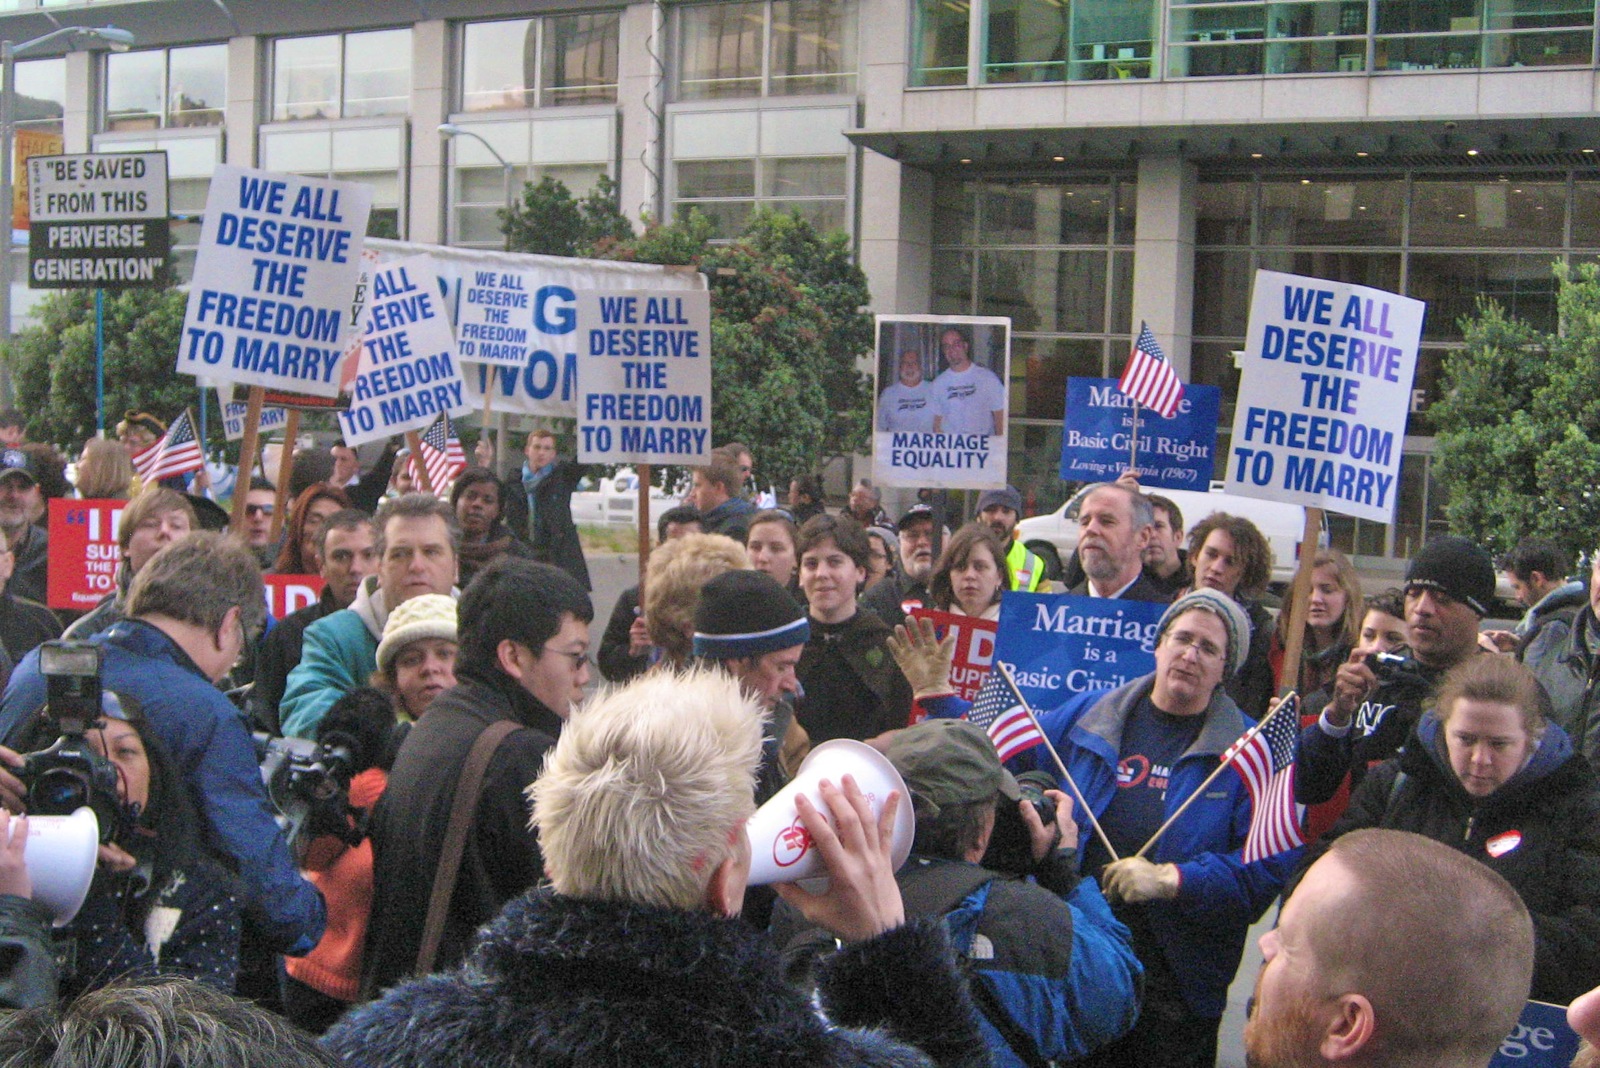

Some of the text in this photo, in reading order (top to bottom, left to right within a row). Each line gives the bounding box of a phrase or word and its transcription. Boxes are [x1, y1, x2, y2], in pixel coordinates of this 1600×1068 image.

[46, 158, 146, 181] "BE SAVED
[47, 192, 95, 213] FROM
[101, 191, 148, 212] THIS
[239, 176, 342, 223] WE ALL
[48, 224, 146, 249] PERVERSE
[216, 212, 351, 264] DESERVE
[33, 257, 163, 281] GENERATION"
[252, 258, 307, 298] THE
[374, 266, 417, 300] ALL
[475, 271, 524, 291] WE ALL
[467, 288, 529, 309] DESERVE
[599, 297, 689, 325] WE ALL
[1284, 285, 1394, 338] WE ALL
[197, 290, 341, 343] FREEDOM
[365, 293, 435, 335] ERVE
[485, 307, 510, 325] THE
[364, 331, 412, 365] THE
[462, 323, 527, 344] FREEDOM
[589, 329, 699, 358] DESERVE
[187, 327, 341, 383] TO MARRY
[458, 340, 528, 361] TO MARRY
[1261, 324, 1403, 383] DESERVE
[355, 351, 454, 401] REEDOM
[621, 362, 667, 389] THE
[342, 380, 463, 436] TO MARRY
[586, 393, 703, 422] FREEDOM
[1301, 372, 1360, 415] THE
[225, 419, 240, 434] TO
[581, 425, 708, 455] TO MARRY
[892, 432, 990, 450] MARRIAGE
[1244, 406, 1394, 467] FREEDOM
[891, 450, 989, 469] EQUALITY
[1068, 430, 1108, 449] Basic
[1157, 436, 1209, 462] Right
[1069, 459, 1108, 475] Loving
[1235, 447, 1393, 508] TO MARRY
[85, 561, 112, 572] THE
[85, 574, 111, 589] TO
[1032, 603, 1159, 653] Marriag
[1083, 642, 1117, 663] is a
